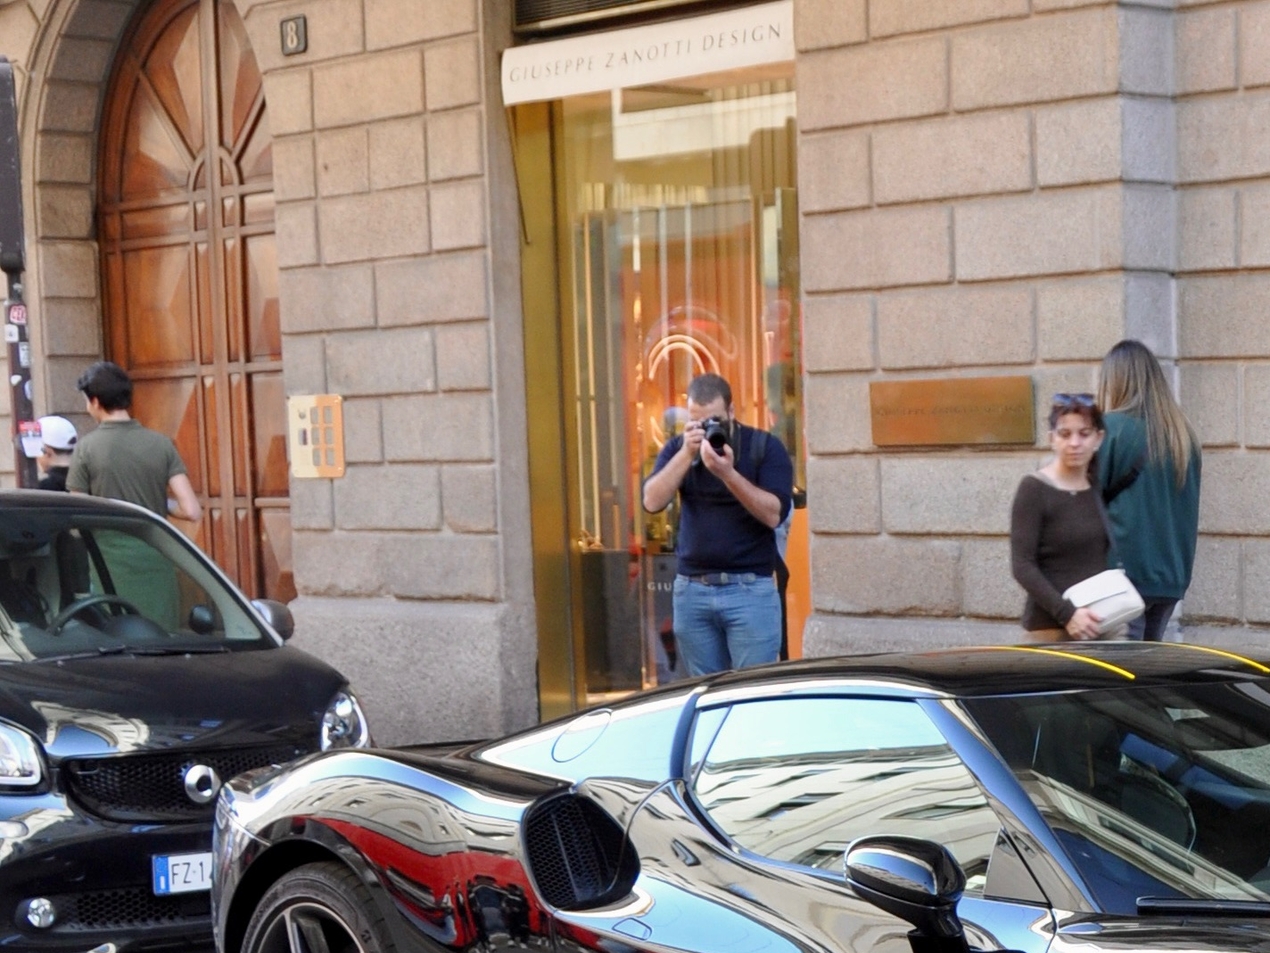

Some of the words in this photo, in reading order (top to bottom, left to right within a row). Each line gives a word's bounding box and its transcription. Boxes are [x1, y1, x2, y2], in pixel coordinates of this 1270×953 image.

[287, 21, 298, 49] 8
[509, 56, 595, 82] GIUSEPPE
[605, 40, 692, 68] ZANOTTI
[702, 22, 782, 51] DESIGN
